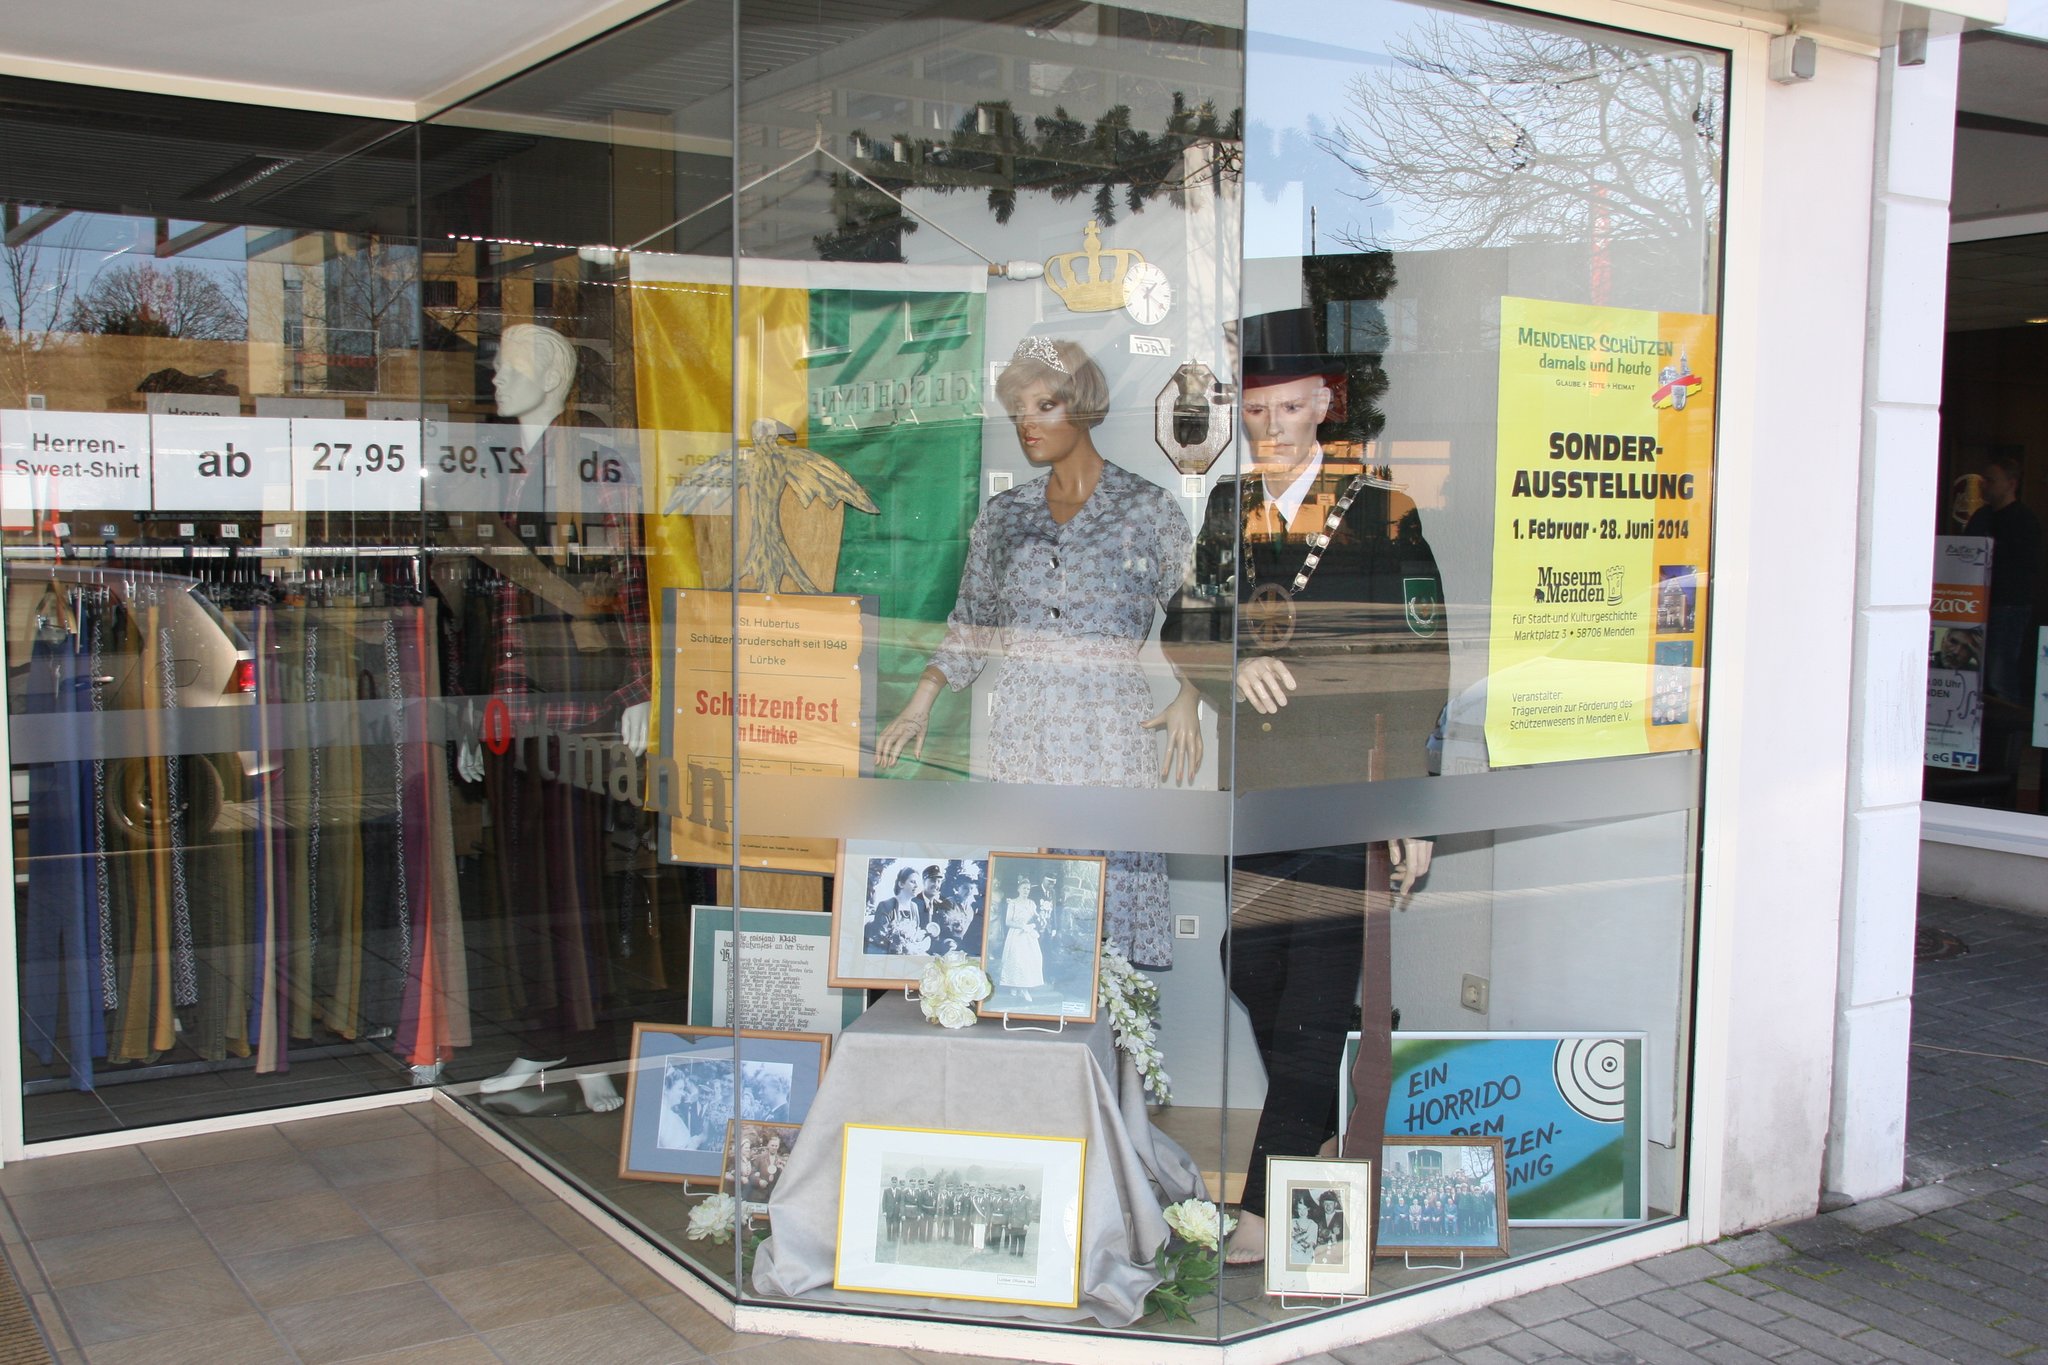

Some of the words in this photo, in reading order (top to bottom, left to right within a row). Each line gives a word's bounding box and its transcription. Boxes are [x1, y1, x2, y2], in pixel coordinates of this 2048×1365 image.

[1518, 327, 1597, 351] MENDENER
[1599, 334, 1673, 356] SCHÜTZEN
[1539, 353, 1586, 371] damals
[1590, 358, 1613, 373] und
[1618, 358, 1651, 375] heute
[33, 433, 126, 453] Herren-
[1549, 432, 1663, 462] SONDER-
[15, 459, 141, 479] Sweat-Shirt
[198, 442, 251, 478] ab
[312, 442, 406, 477] 27,95
[1512, 470, 1694, 500] AUSSTELLUNG
[1513, 518, 1524, 540] 1.
[1528, 518, 1590, 540] Februar
[1600, 518, 1621, 540] 28.
[1625, 518, 1654, 540] Juni
[1658, 518, 1689, 540] 2014
[1537, 566, 1602, 587] Museum
[1546, 583, 1605, 603] Menden
[739, 617, 751, 627] St.
[754, 618, 800, 630] Hubertus
[1512, 614, 1526, 625] für
[1570, 610, 1638, 624] Kulturgeschichte
[1514, 629, 1560, 641] Marktplatz
[1561, 629, 1567, 639] 3
[1576, 627, 1601, 639] 58706
[1603, 626, 1635, 637] Menden
[802, 640, 821, 649] seit
[823, 639, 848, 650] 1948
[750, 655, 786, 666] Lürbke
[695, 689, 839, 723] Schützenfest
[1511, 704, 1562, 717] Trägerverein
[1564, 704, 1577, 713] zur
[1578, 700, 1618, 712] Förderung
[1619, 699, 1633, 709] des
[1510, 717, 1576, 730] Schützenwesens
[1577, 715, 1584, 725] in
[1585, 713, 1616, 724] Menden
[1617, 712, 1631, 722] e.V.
[749, 723, 798, 745] Lürbke
[1407, 1062, 1448, 1098] EIN
[1404, 1074, 1521, 1132] HORRIDO
